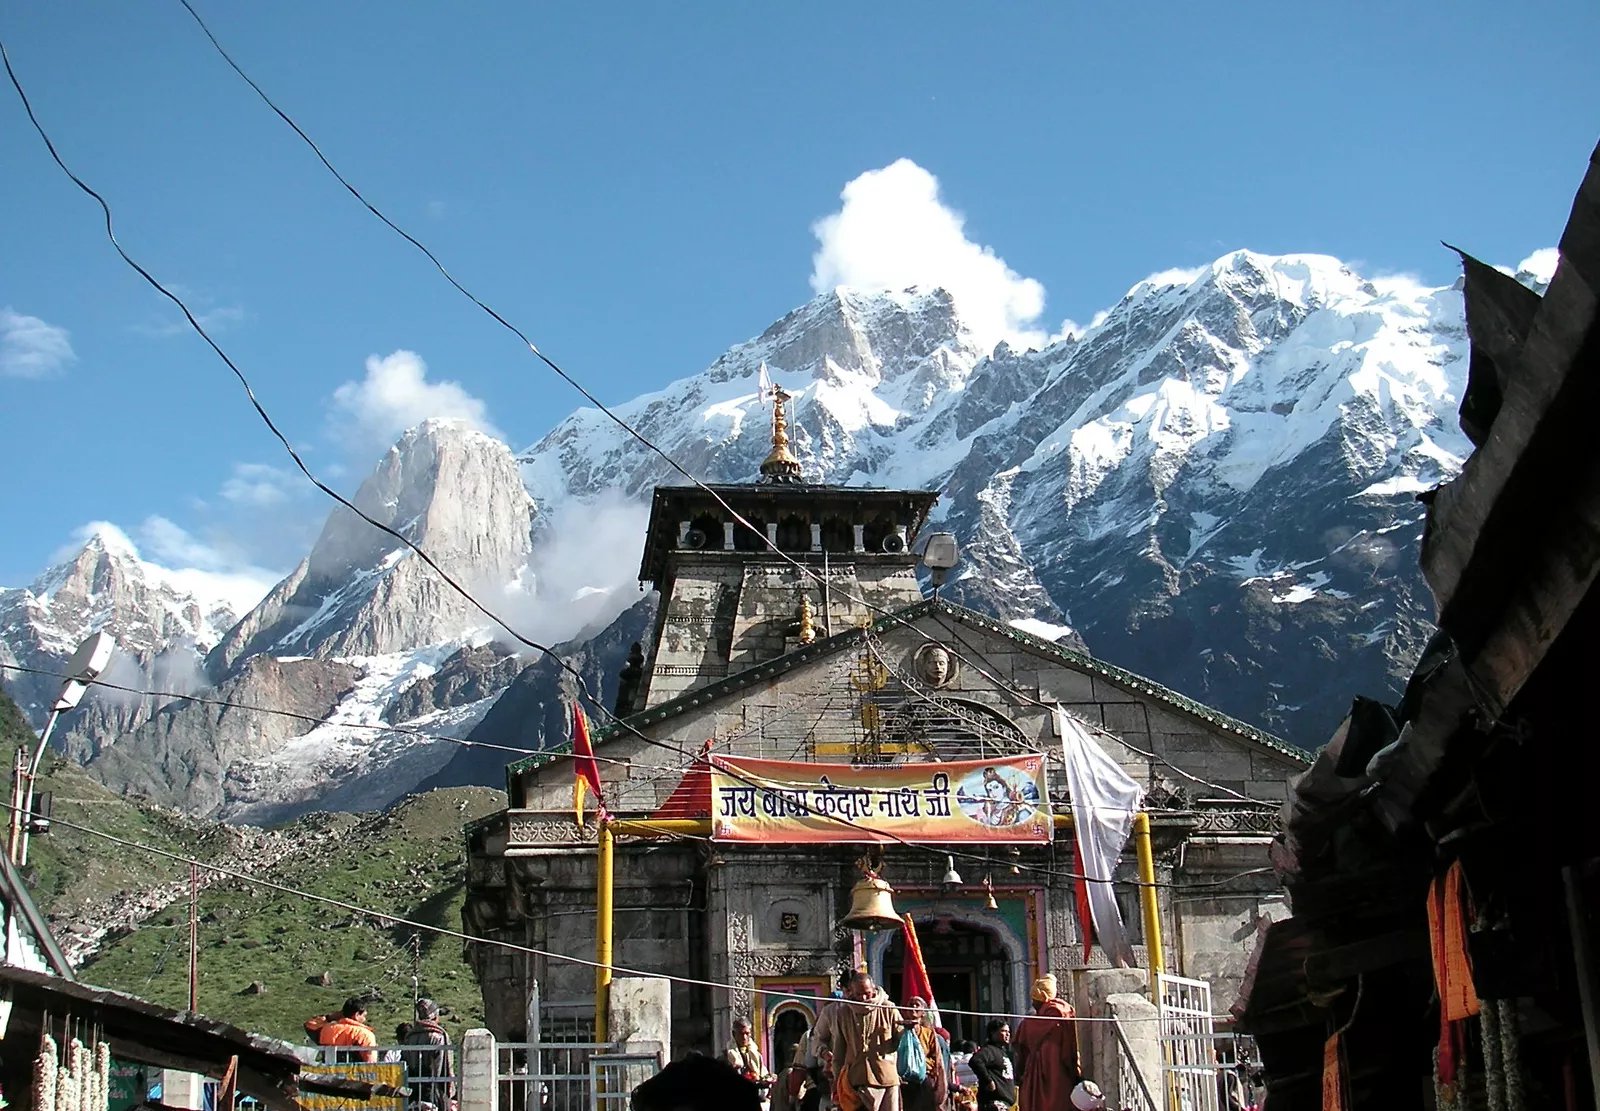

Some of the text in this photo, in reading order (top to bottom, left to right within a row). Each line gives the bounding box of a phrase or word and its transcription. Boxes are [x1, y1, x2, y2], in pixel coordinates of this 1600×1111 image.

[719, 772, 952, 821] जय बाबा केदार नाथ जी
